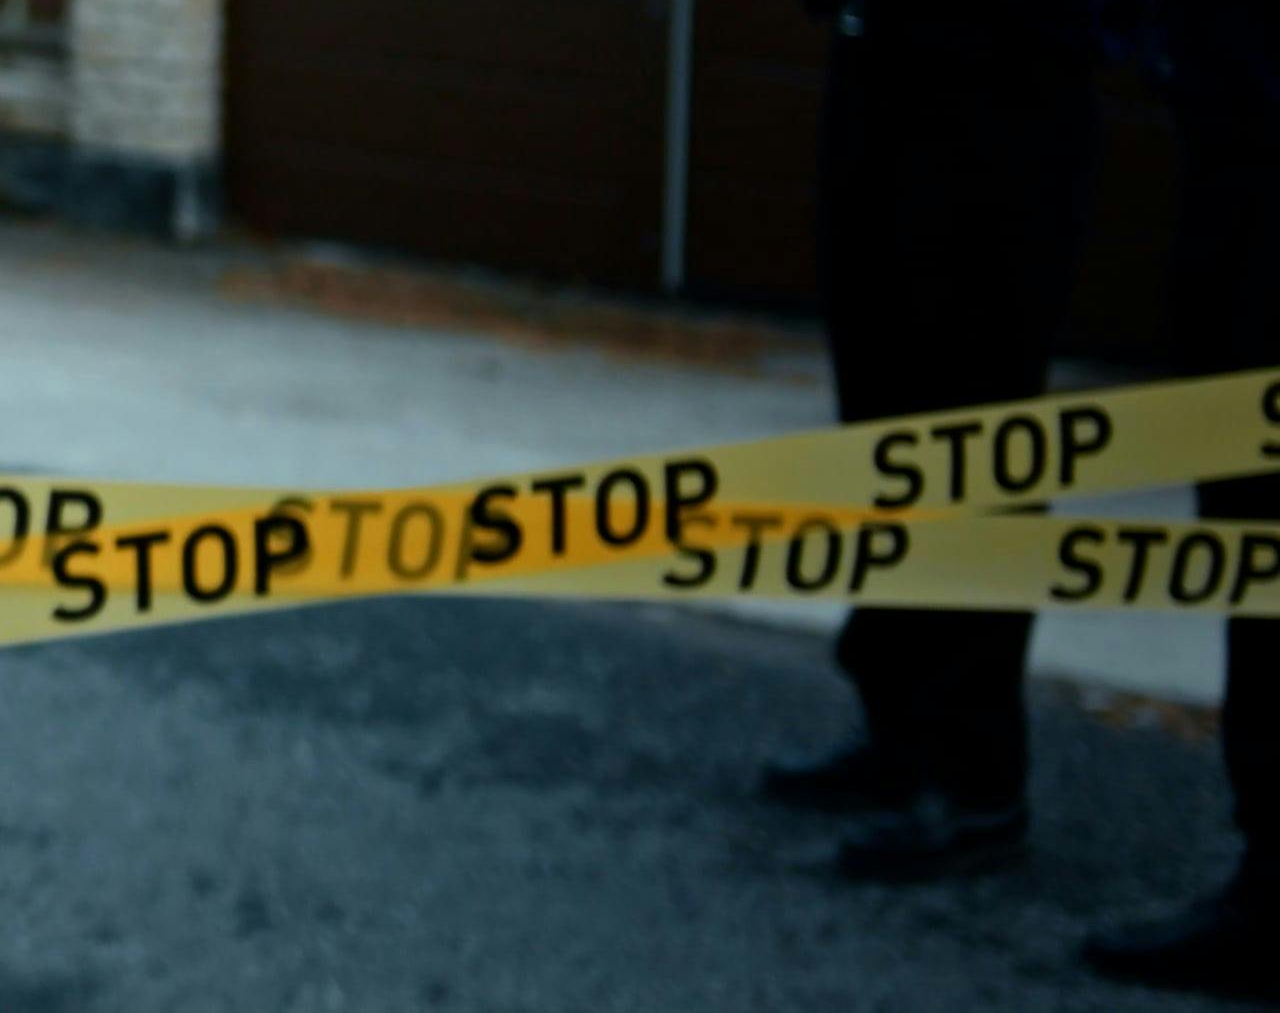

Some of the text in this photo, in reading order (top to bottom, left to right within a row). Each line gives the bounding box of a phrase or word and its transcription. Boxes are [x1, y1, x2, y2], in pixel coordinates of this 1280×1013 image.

[51, 515, 312, 623] STOP
[470, 455, 719, 564] STOP
[872, 404, 1113, 511] STOP
[661, 515, 910, 595] STOP
[1050, 525, 1280, 606] STOP
